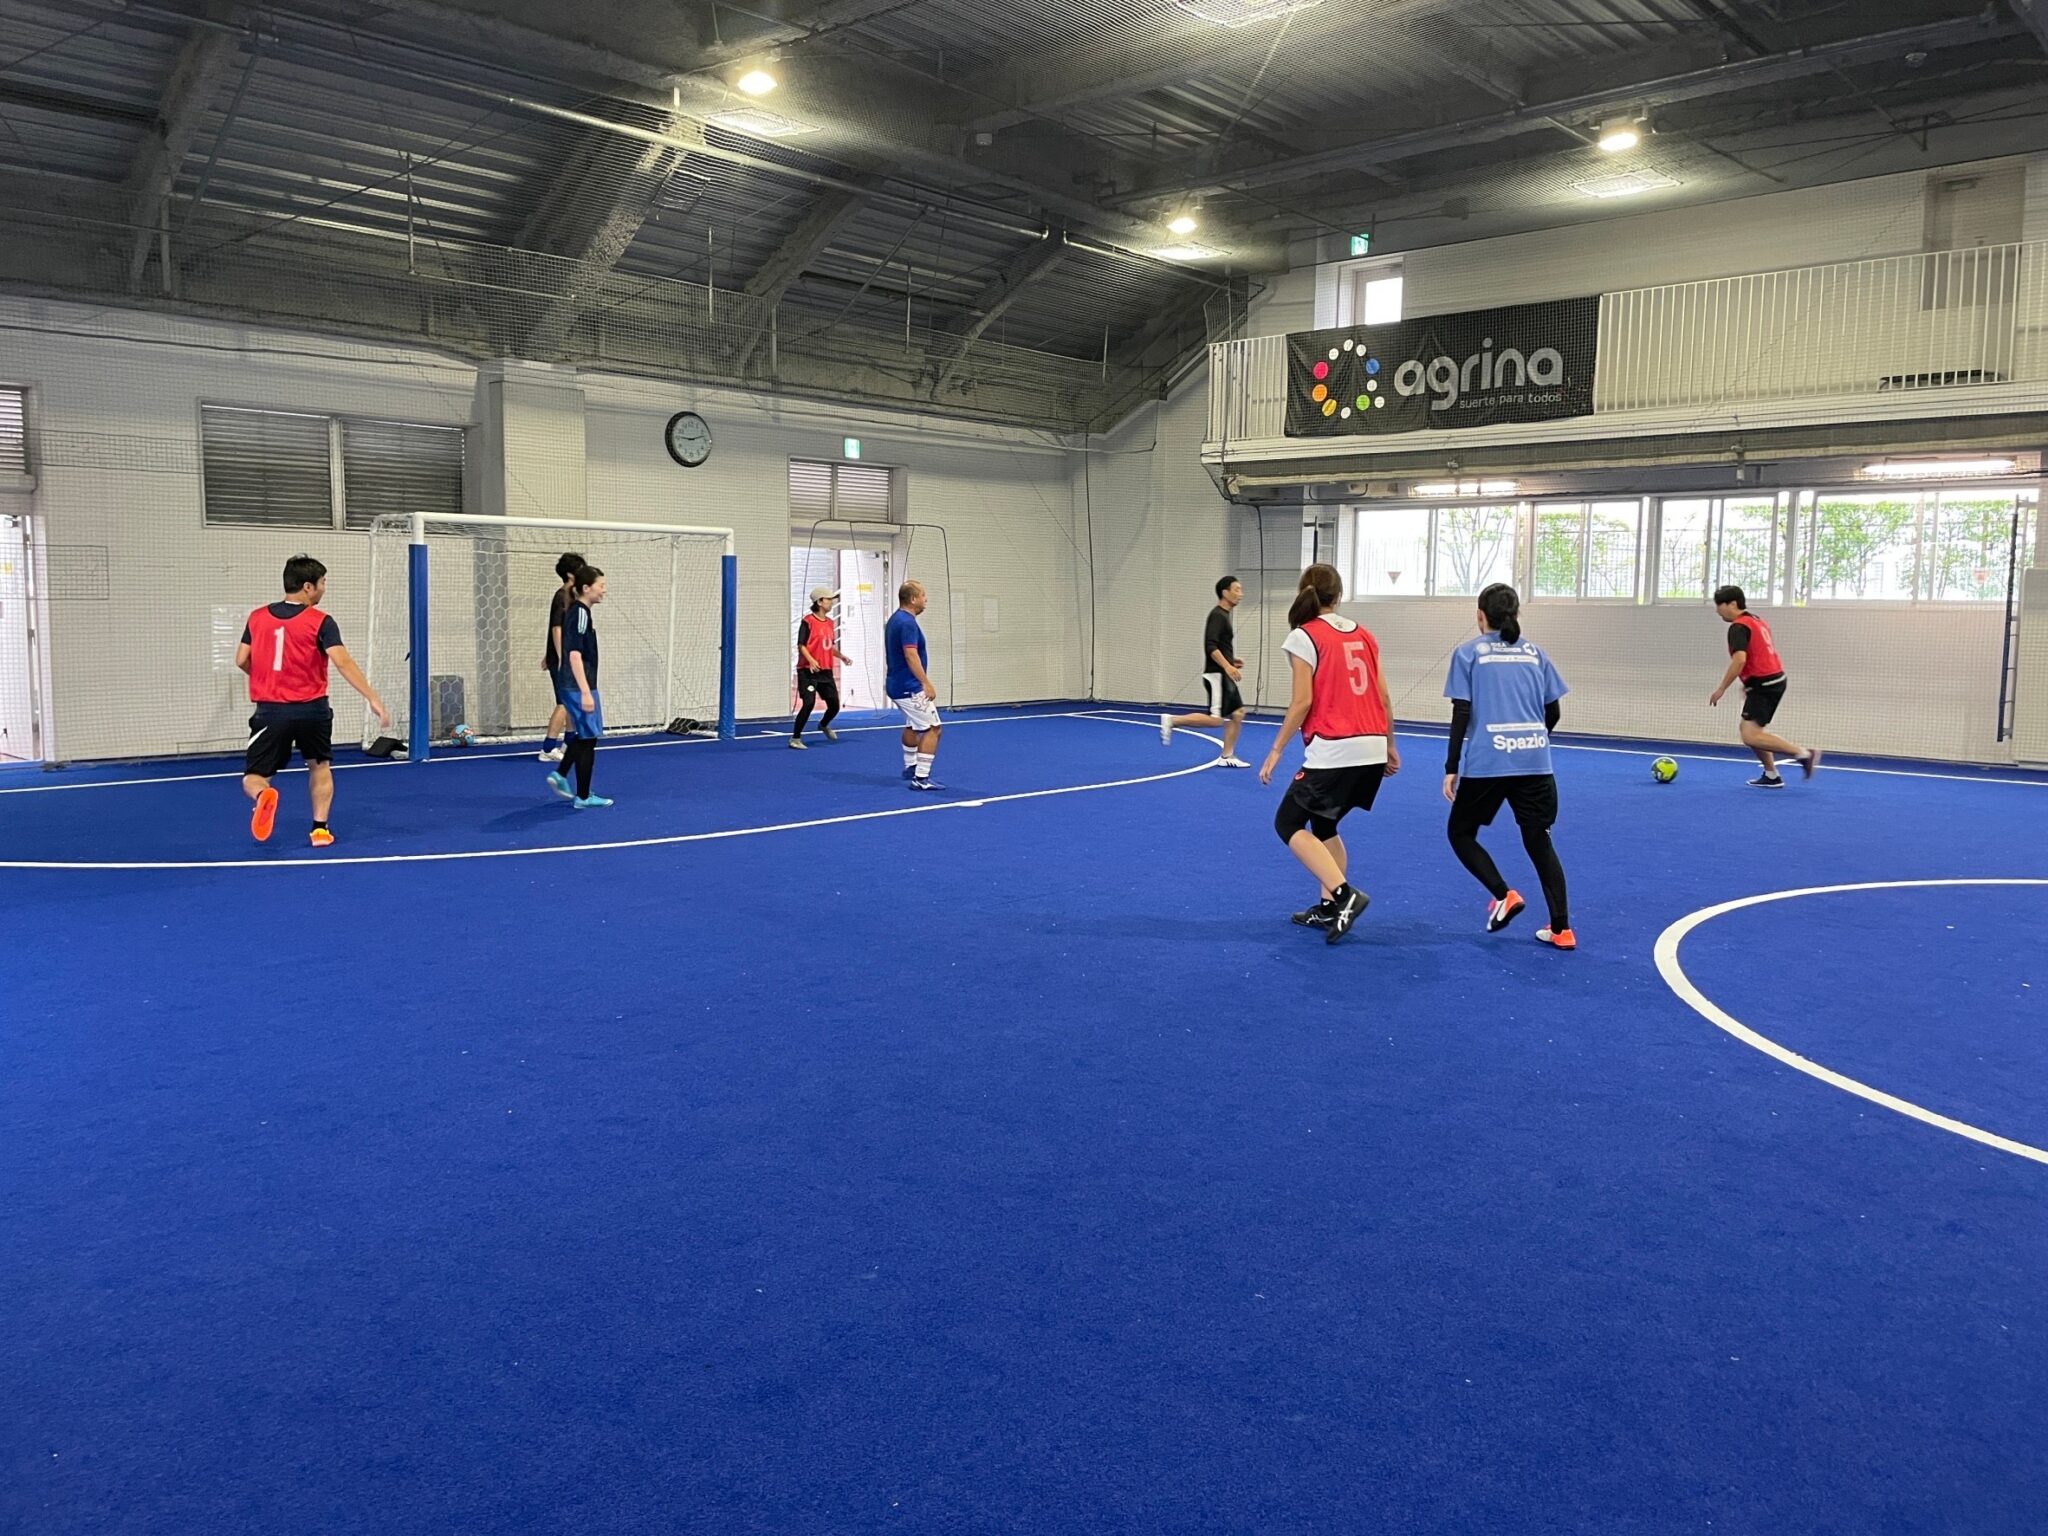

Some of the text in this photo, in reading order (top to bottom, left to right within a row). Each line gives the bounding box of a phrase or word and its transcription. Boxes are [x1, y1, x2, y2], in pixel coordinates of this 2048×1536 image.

[1394, 337, 1564, 411] agrina
[1460, 391, 1562, 409] suerte para todos
[273, 626, 285, 671] 1
[1343, 641, 1368, 696] 5
[1493, 732, 1546, 753] Spazio
